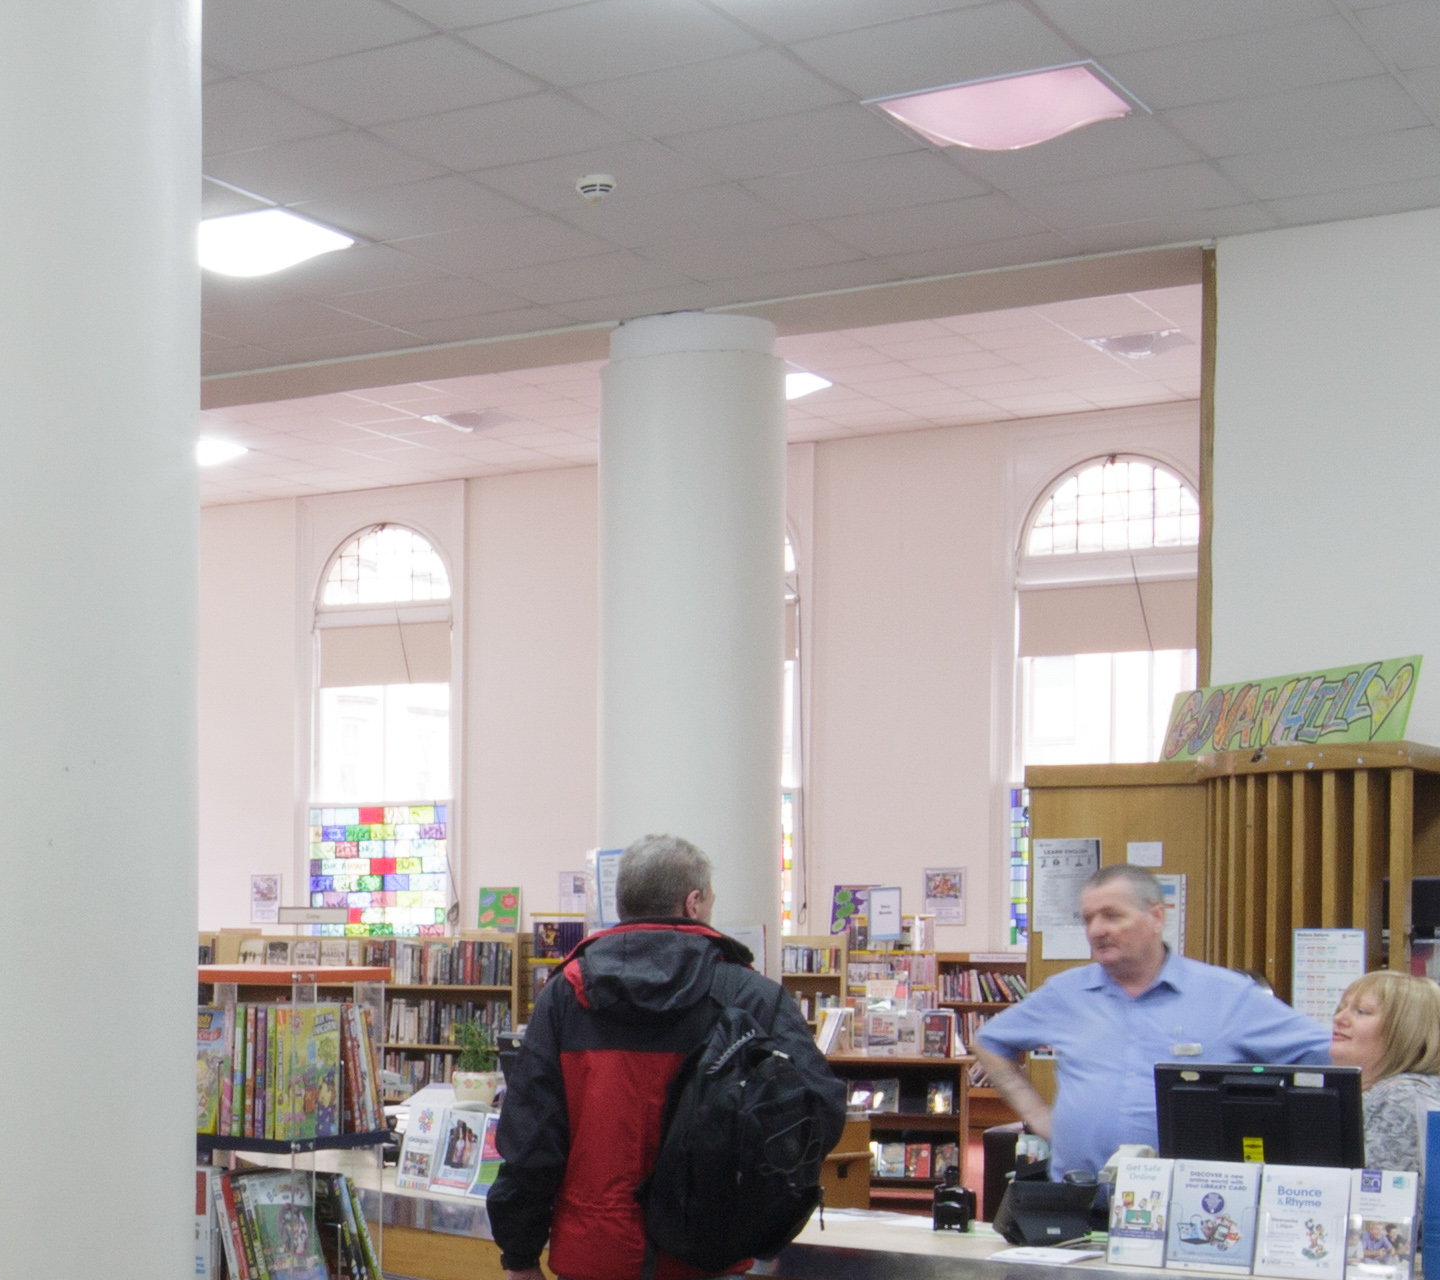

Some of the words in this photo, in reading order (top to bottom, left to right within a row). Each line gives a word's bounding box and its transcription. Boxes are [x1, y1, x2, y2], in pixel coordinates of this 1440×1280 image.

[1164, 661, 1382, 760] GOVANHILL
[1126, 1163, 1141, 1172] Get
[1142, 1163, 1162, 1172] Safe
[1129, 1172, 1157, 1182] Online
[1189, 1171, 1223, 1179] DISCOVER
[1277, 1186, 1322, 1197] Bounce
[1285, 1197, 1322, 1209] Rhyme
